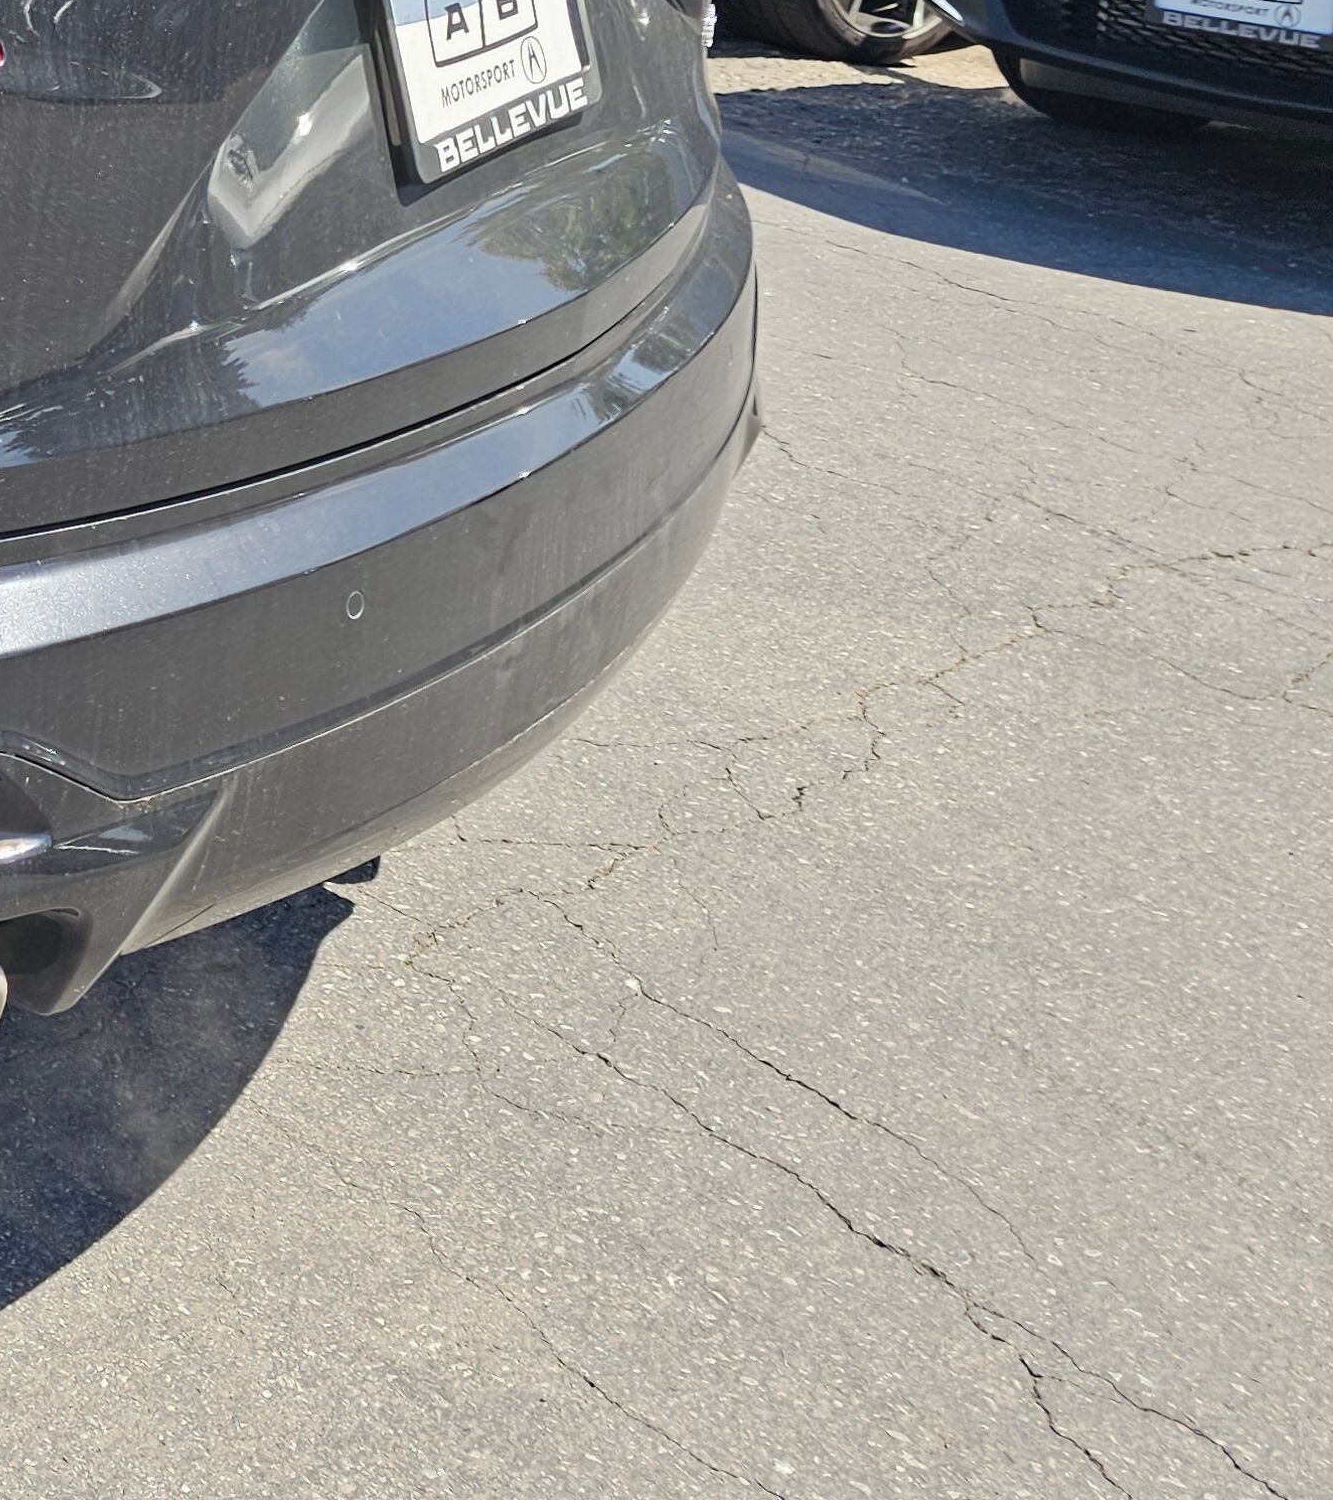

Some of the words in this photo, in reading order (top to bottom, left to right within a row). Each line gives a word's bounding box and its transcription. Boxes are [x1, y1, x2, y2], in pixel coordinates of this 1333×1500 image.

[444, 2, 470, 41] A
[1162, 10, 1321, 49] BELLEVUE
[440, 59, 515, 108] MOTORSPORT
[434, 78, 588, 172] BELLEVUE
